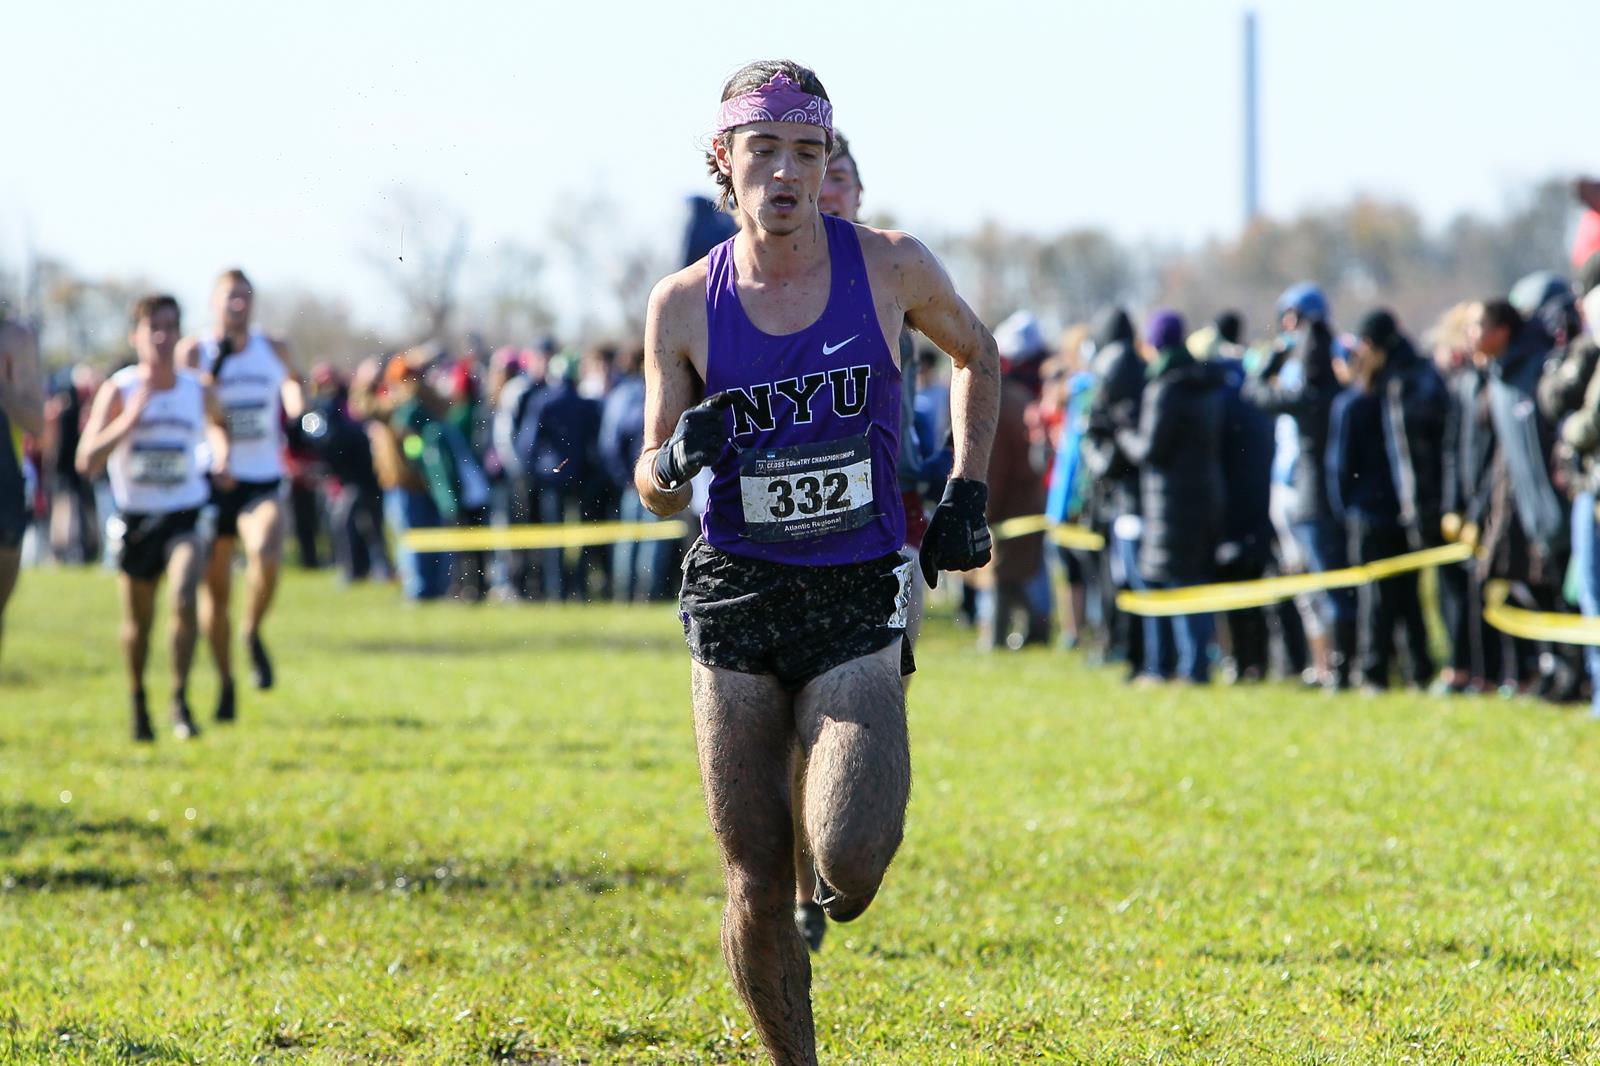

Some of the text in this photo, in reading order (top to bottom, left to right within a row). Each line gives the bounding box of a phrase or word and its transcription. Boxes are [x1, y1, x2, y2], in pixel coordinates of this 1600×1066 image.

[727, 365, 870, 436] NYU
[786, 457, 810, 467] COUNTRY
[811, 450, 855, 464] CHAMPIONSHIPS
[767, 472, 852, 518] 332
[784, 522, 811, 532] Atlantic
[812, 517, 842, 528] Regional
